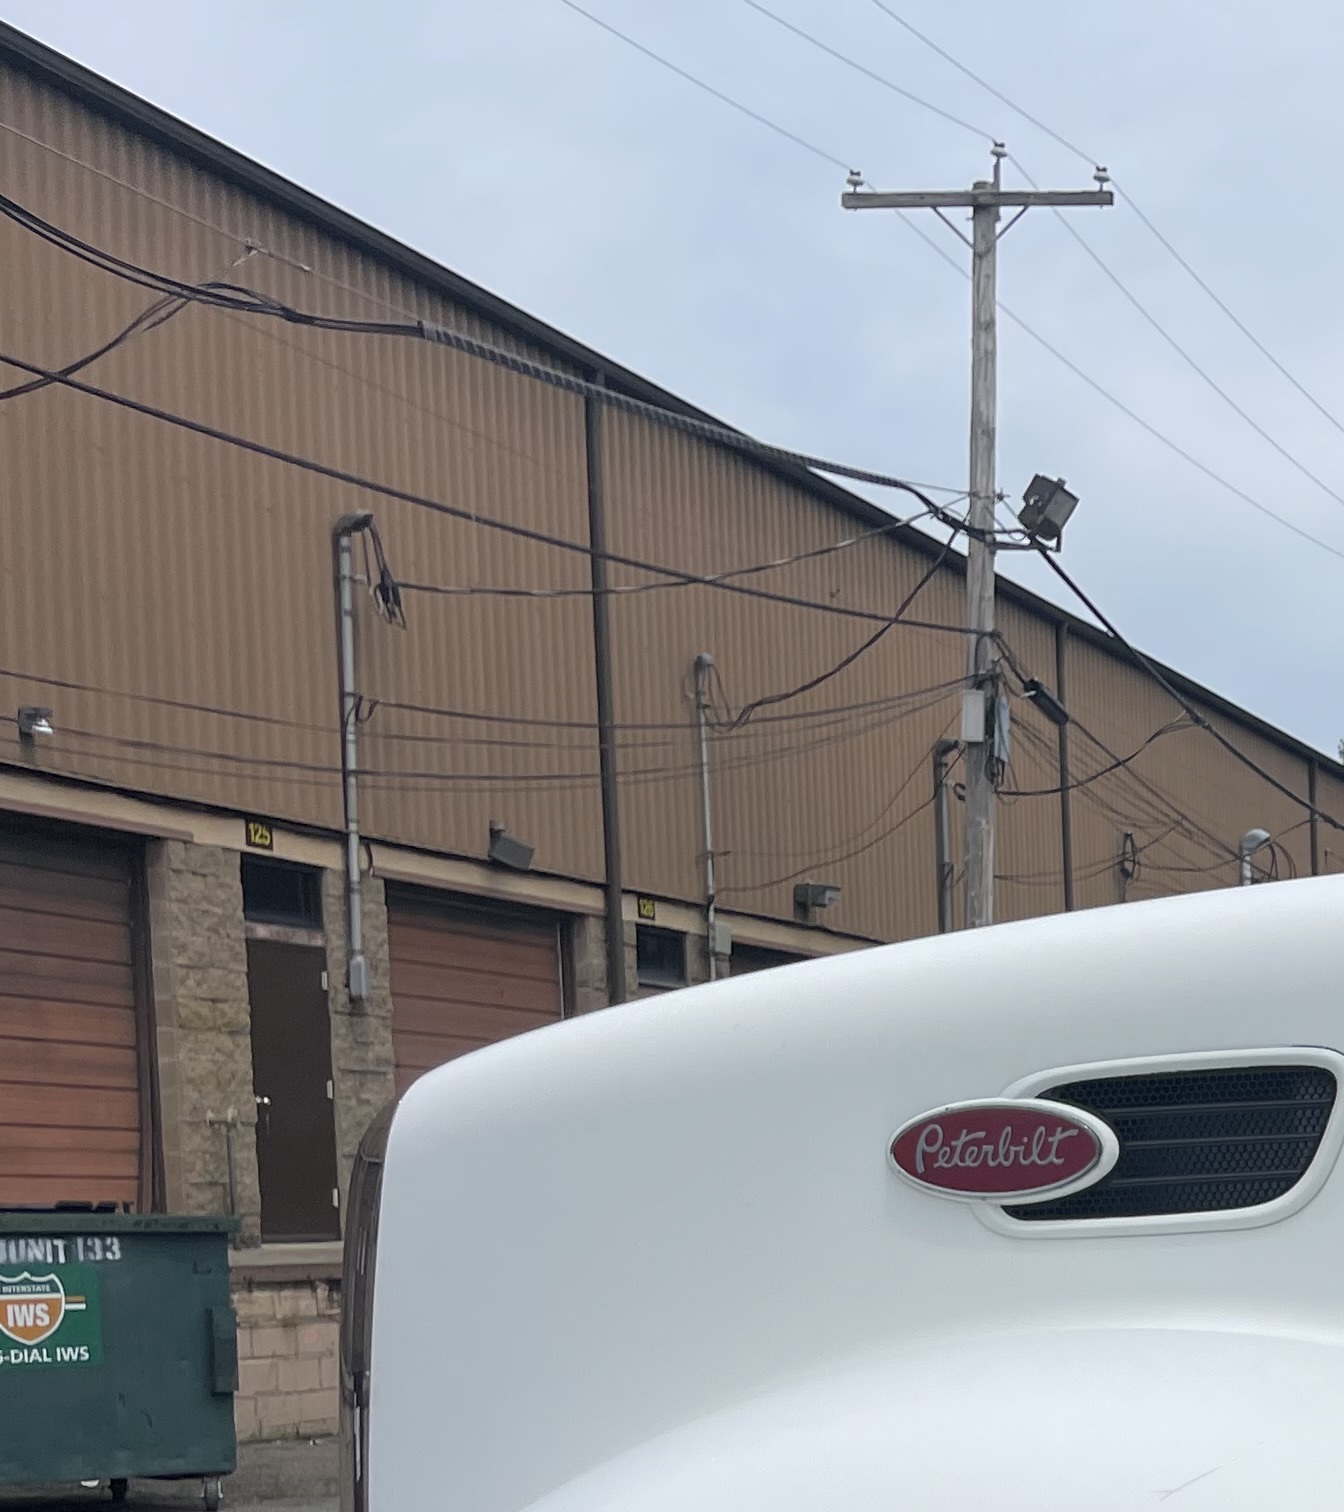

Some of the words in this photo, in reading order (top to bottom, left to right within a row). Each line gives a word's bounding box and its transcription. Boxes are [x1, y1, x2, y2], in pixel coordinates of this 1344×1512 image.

[915, 1123, 1079, 1174] Peterbilt
[6, 1303, 51, 1328] IWS
[56, 1345, 90, 1362] IWS
